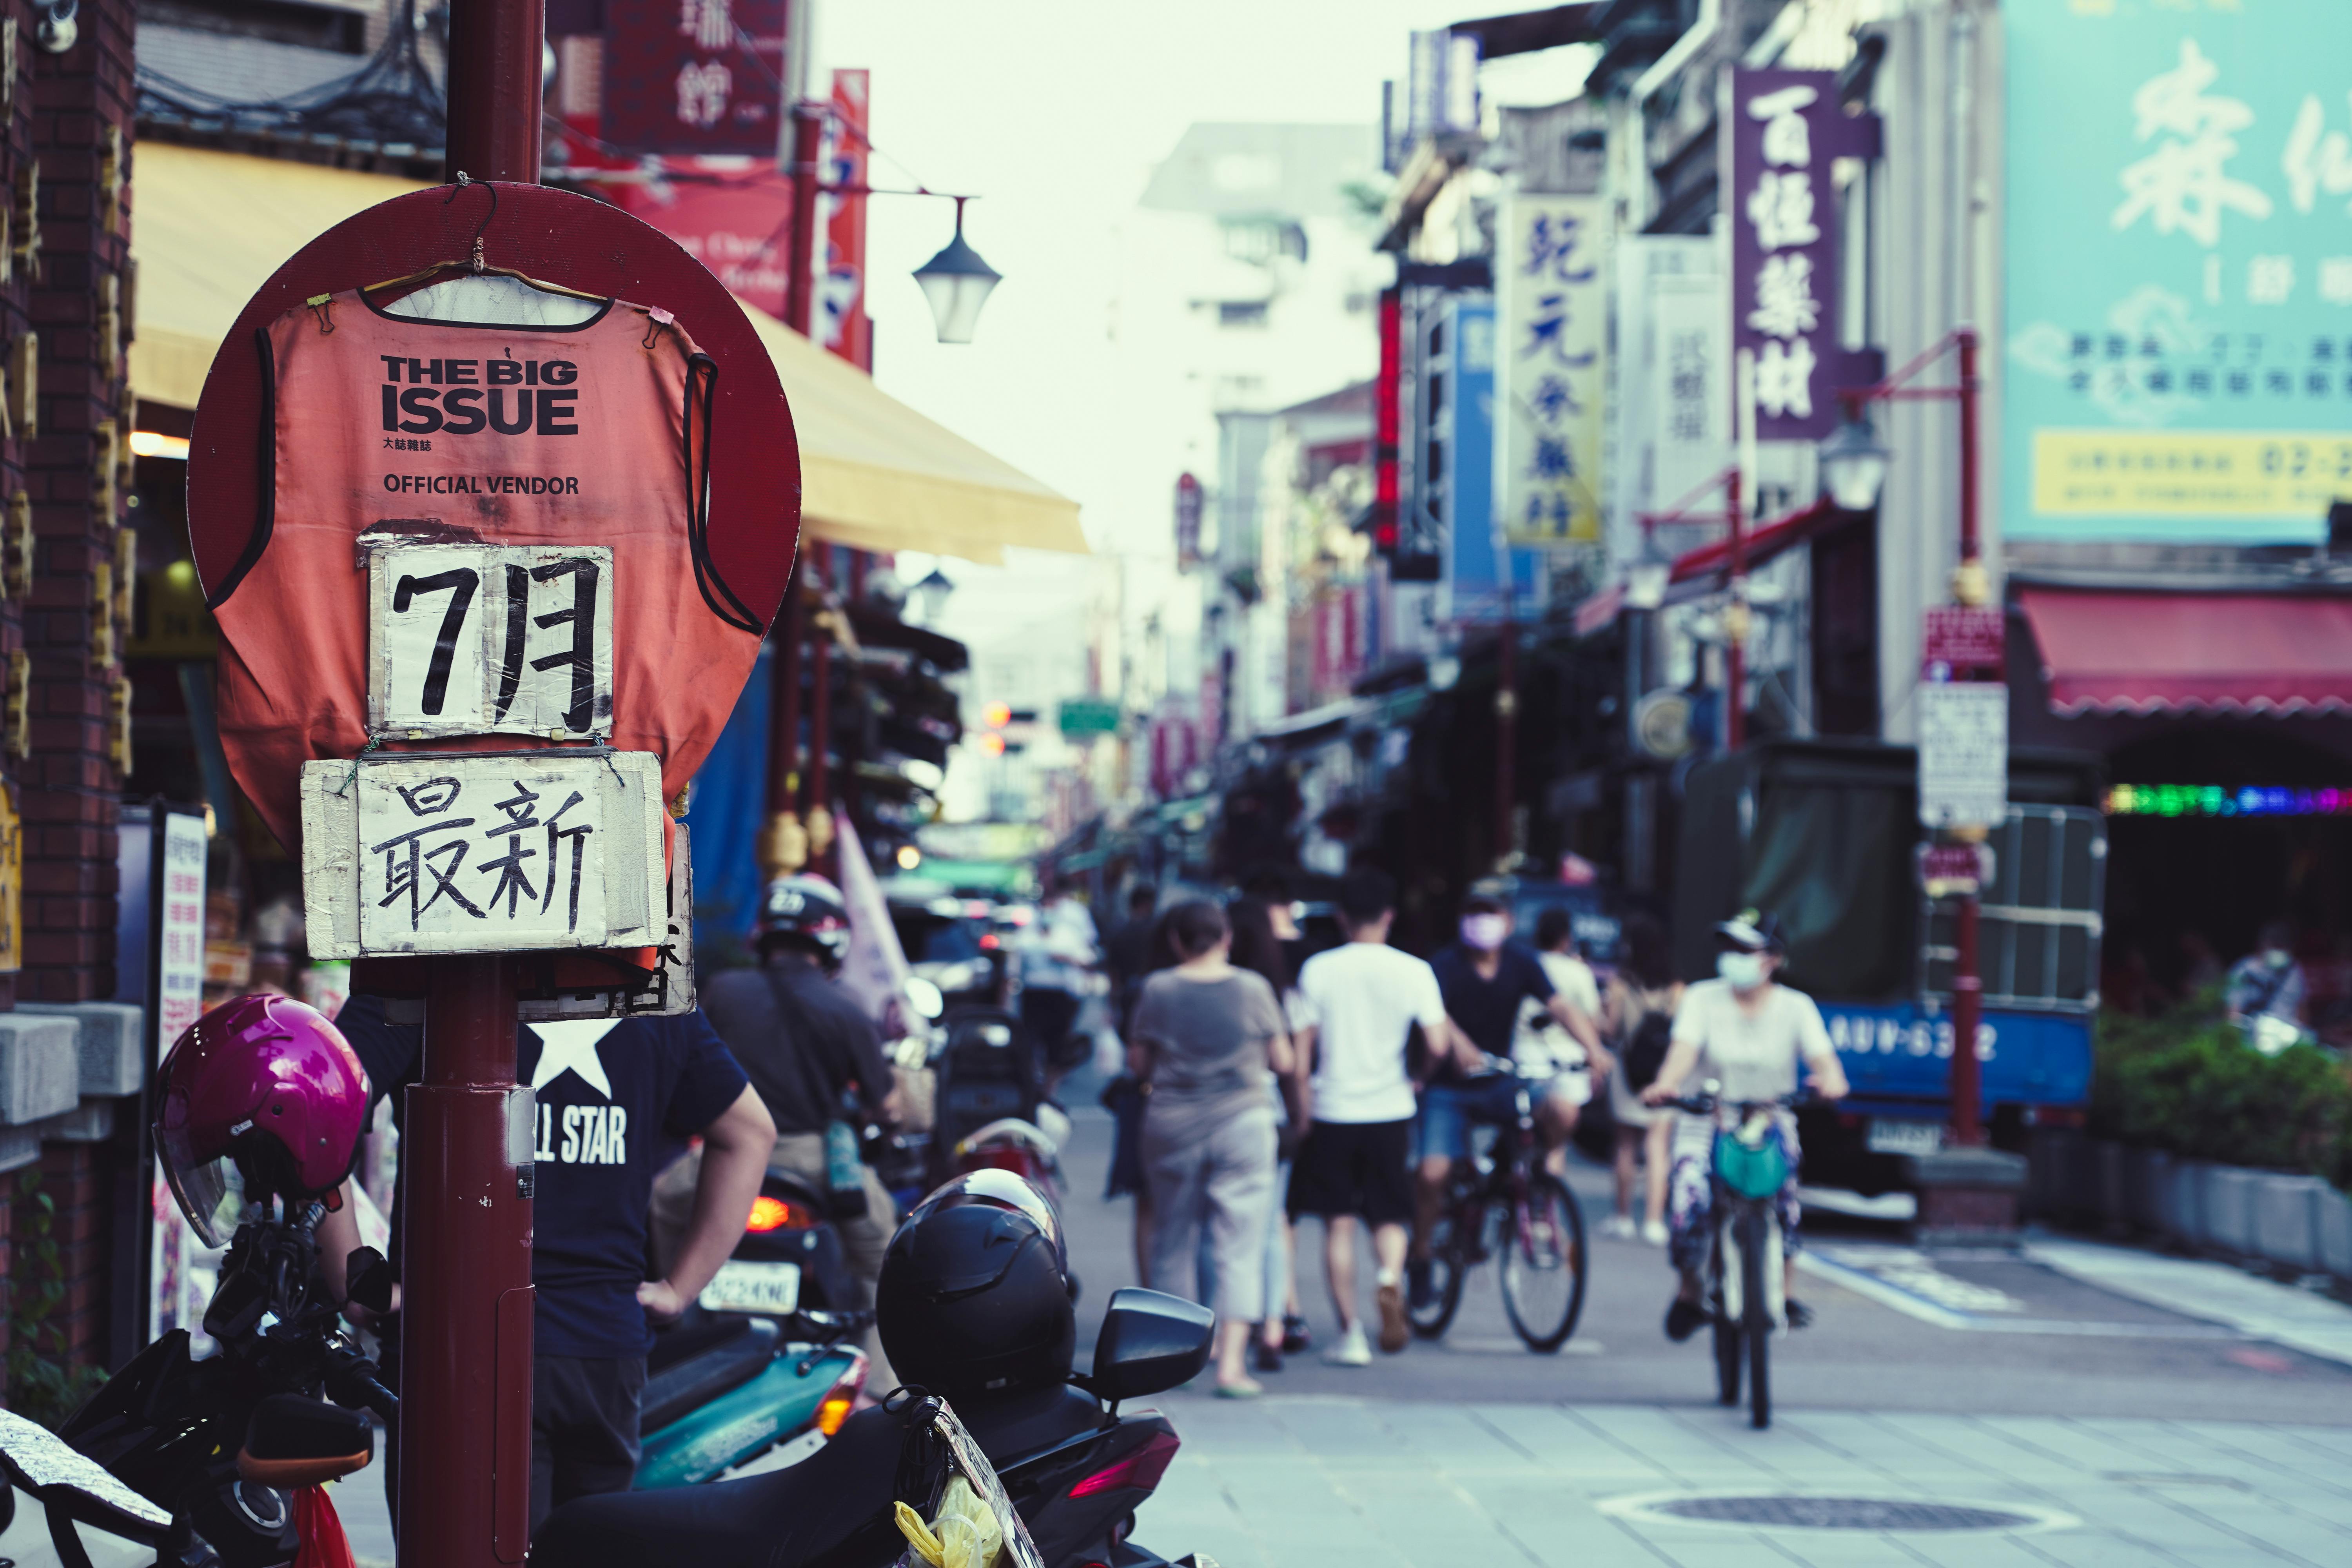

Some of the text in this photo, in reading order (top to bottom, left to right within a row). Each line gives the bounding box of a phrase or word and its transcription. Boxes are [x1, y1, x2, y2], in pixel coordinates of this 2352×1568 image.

[381, 355, 578, 386] THE BIG
[382, 384, 578, 435] ISSUE
[383, 437, 432, 452] 大誌雜誌
[384, 474, 579, 495] OFFICIAL VENDOR
[393, 558, 599, 733] 7月
[370, 776, 593, 935] 最新
[561, 1105, 627, 1164] STAR
